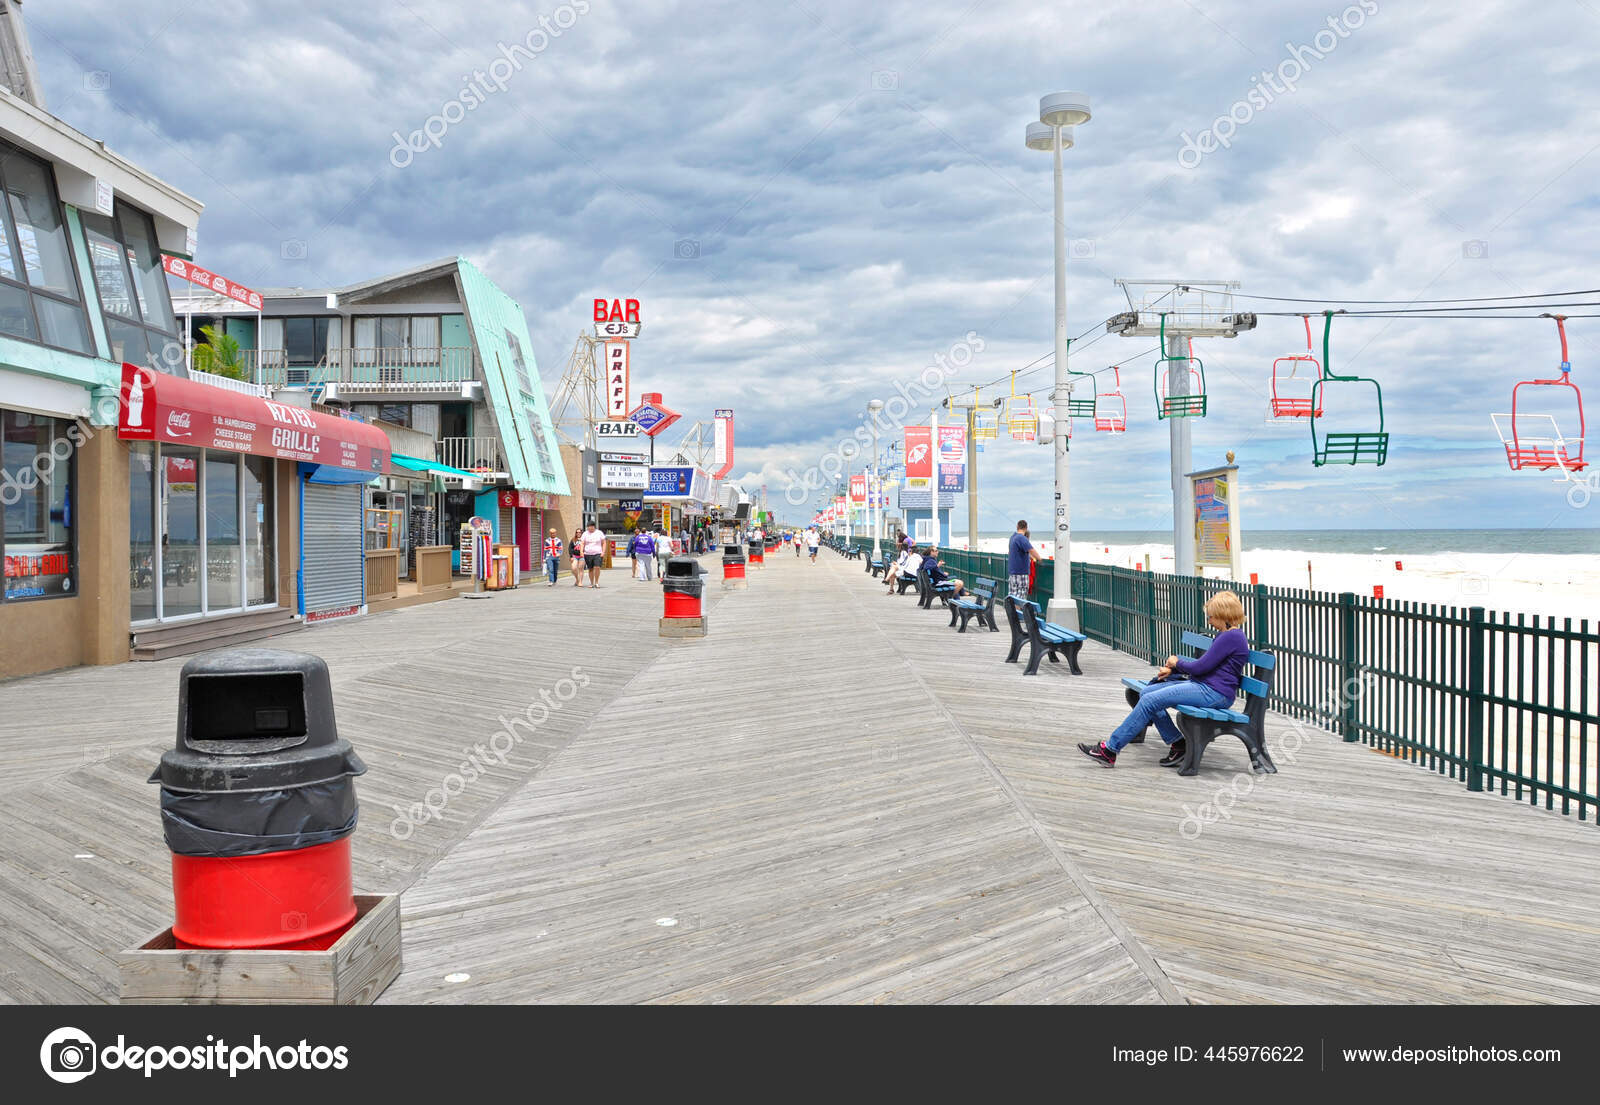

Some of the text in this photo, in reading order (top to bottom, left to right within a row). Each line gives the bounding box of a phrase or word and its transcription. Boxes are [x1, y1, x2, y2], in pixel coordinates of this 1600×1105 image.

[593, 298, 640, 322] BAR
[611, 348, 624, 410] DRAFT
[264, 401, 317, 429] AZTEC
[215, 428, 253, 441] CHEESE STEAKS
[599, 423, 636, 434] BAR
[213, 438, 252, 452] CHICKEN WRAPS
[272, 427, 320, 453] GRILLE
[650, 472, 677, 481] EESE
[649, 482, 675, 492] TEAK
[41, 553, 69, 576] GRILL
